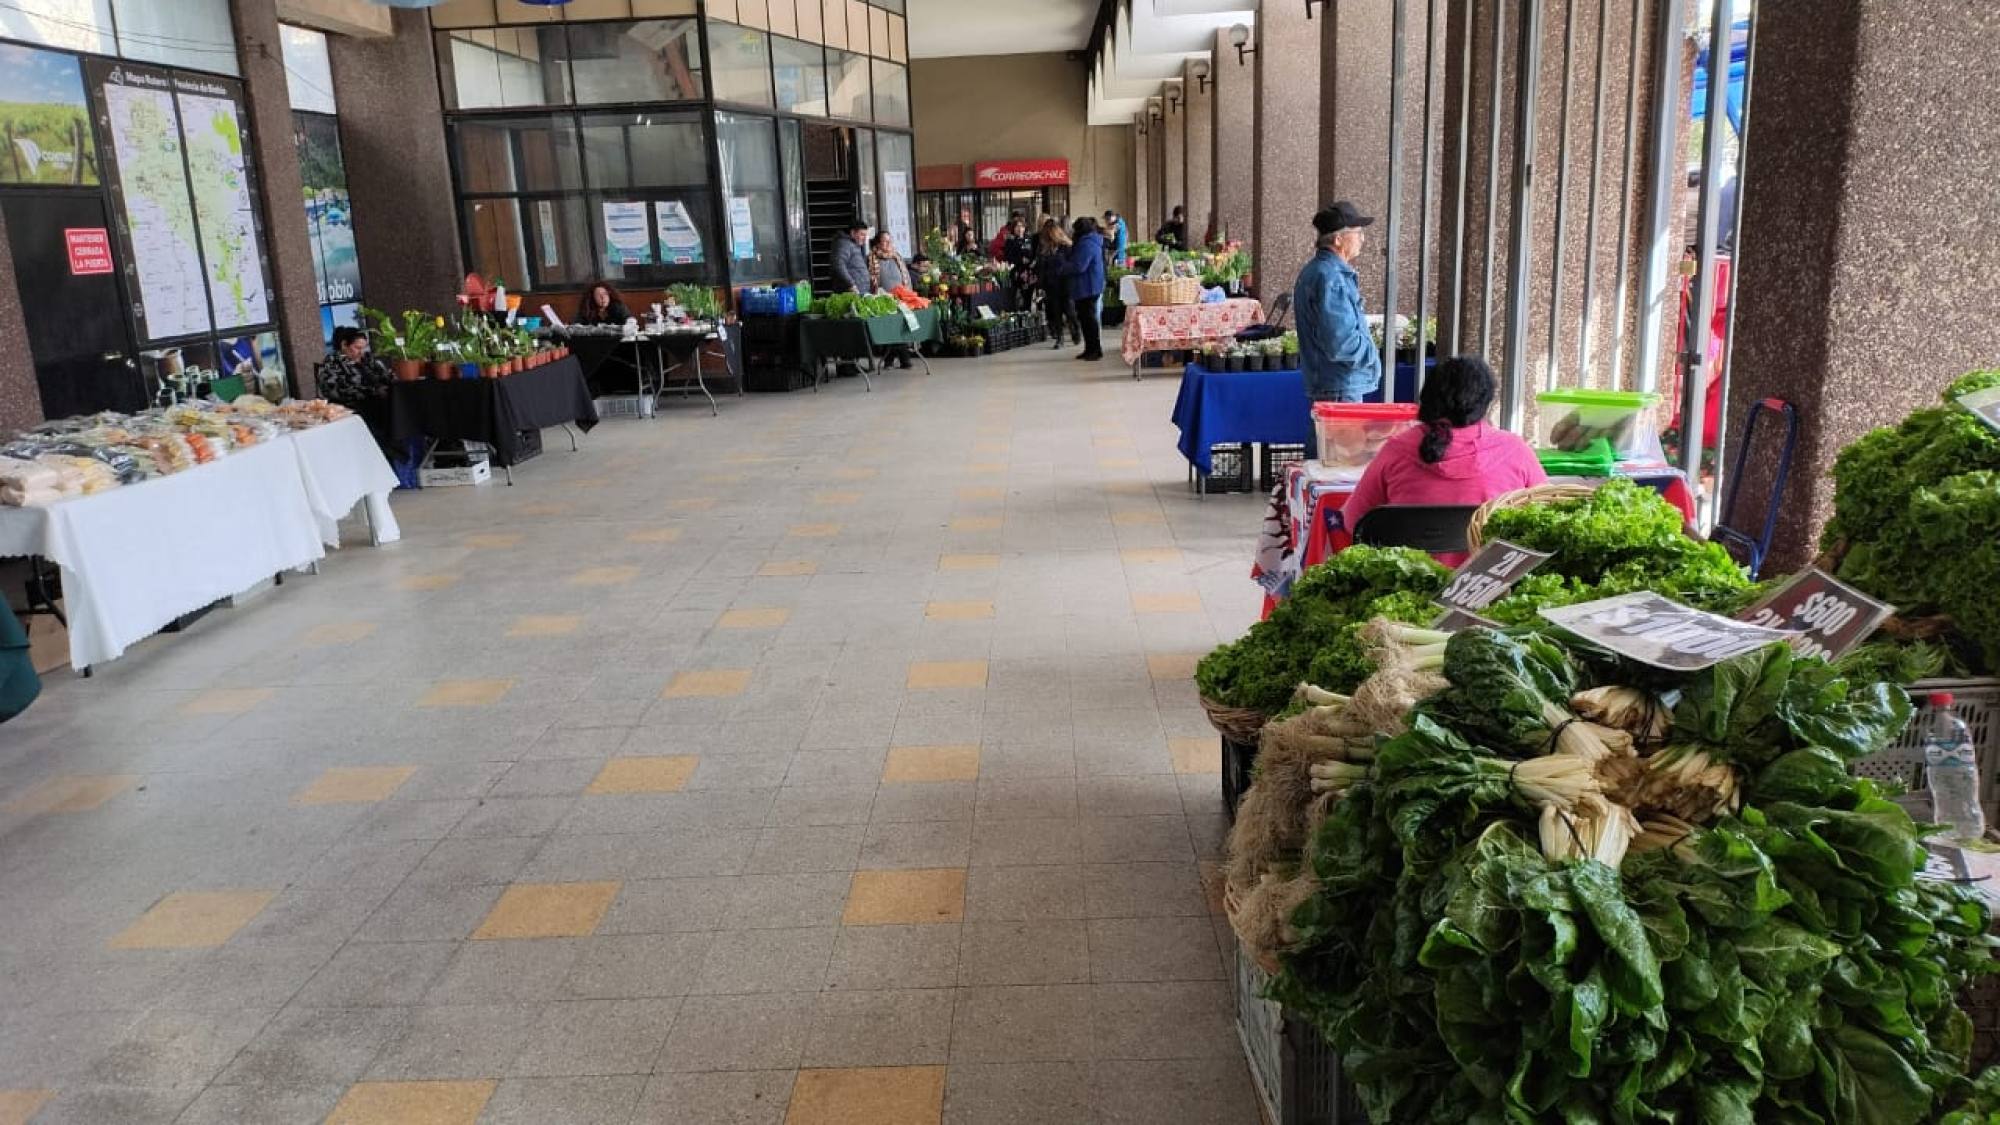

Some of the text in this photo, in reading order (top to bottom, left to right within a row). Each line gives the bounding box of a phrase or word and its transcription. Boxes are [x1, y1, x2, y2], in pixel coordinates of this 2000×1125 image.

[991, 169, 1067, 182] CORREOSCHILE
[69, 234, 104, 243] MANTENER
[74, 246, 104, 256] CERRADA
[75, 258, 108, 269] LA PUERTA
[1792, 591, 1857, 636] $600
